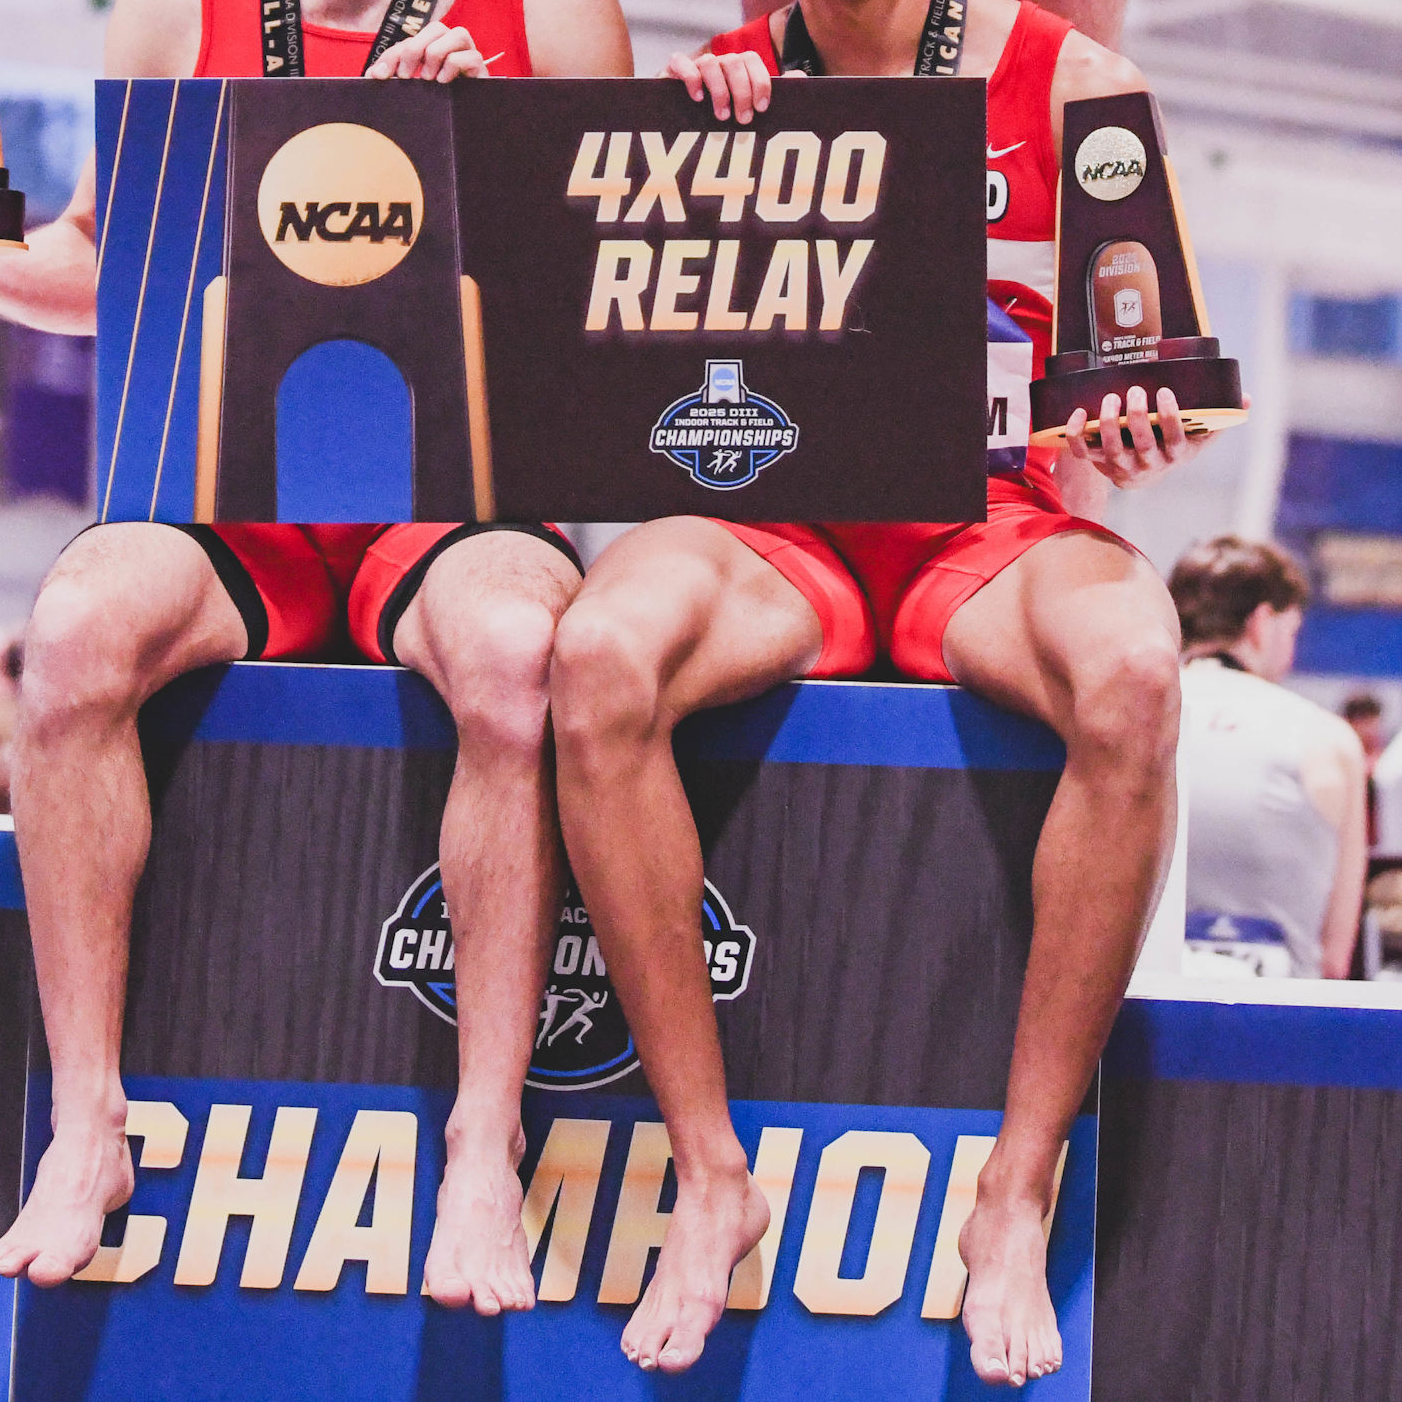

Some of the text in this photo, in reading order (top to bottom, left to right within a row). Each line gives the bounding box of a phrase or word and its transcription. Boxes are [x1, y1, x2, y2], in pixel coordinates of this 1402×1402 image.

[286, 12, 298, 62] DIVISION
[566, 131, 887, 223] 4X400
[1081, 160, 1143, 181] NCAA
[275, 201, 414, 246] NCAA
[1099, 262, 1141, 277] DIVISION
[585, 240, 874, 331] RELAY
[1113, 339, 1135, 349] TRACK
[674, 418, 774, 426] INDOOR TRACK & FIELD
[689, 408, 758, 417] 2025 DIII
[655, 429, 794, 447] CHAMPIONSHIPS
